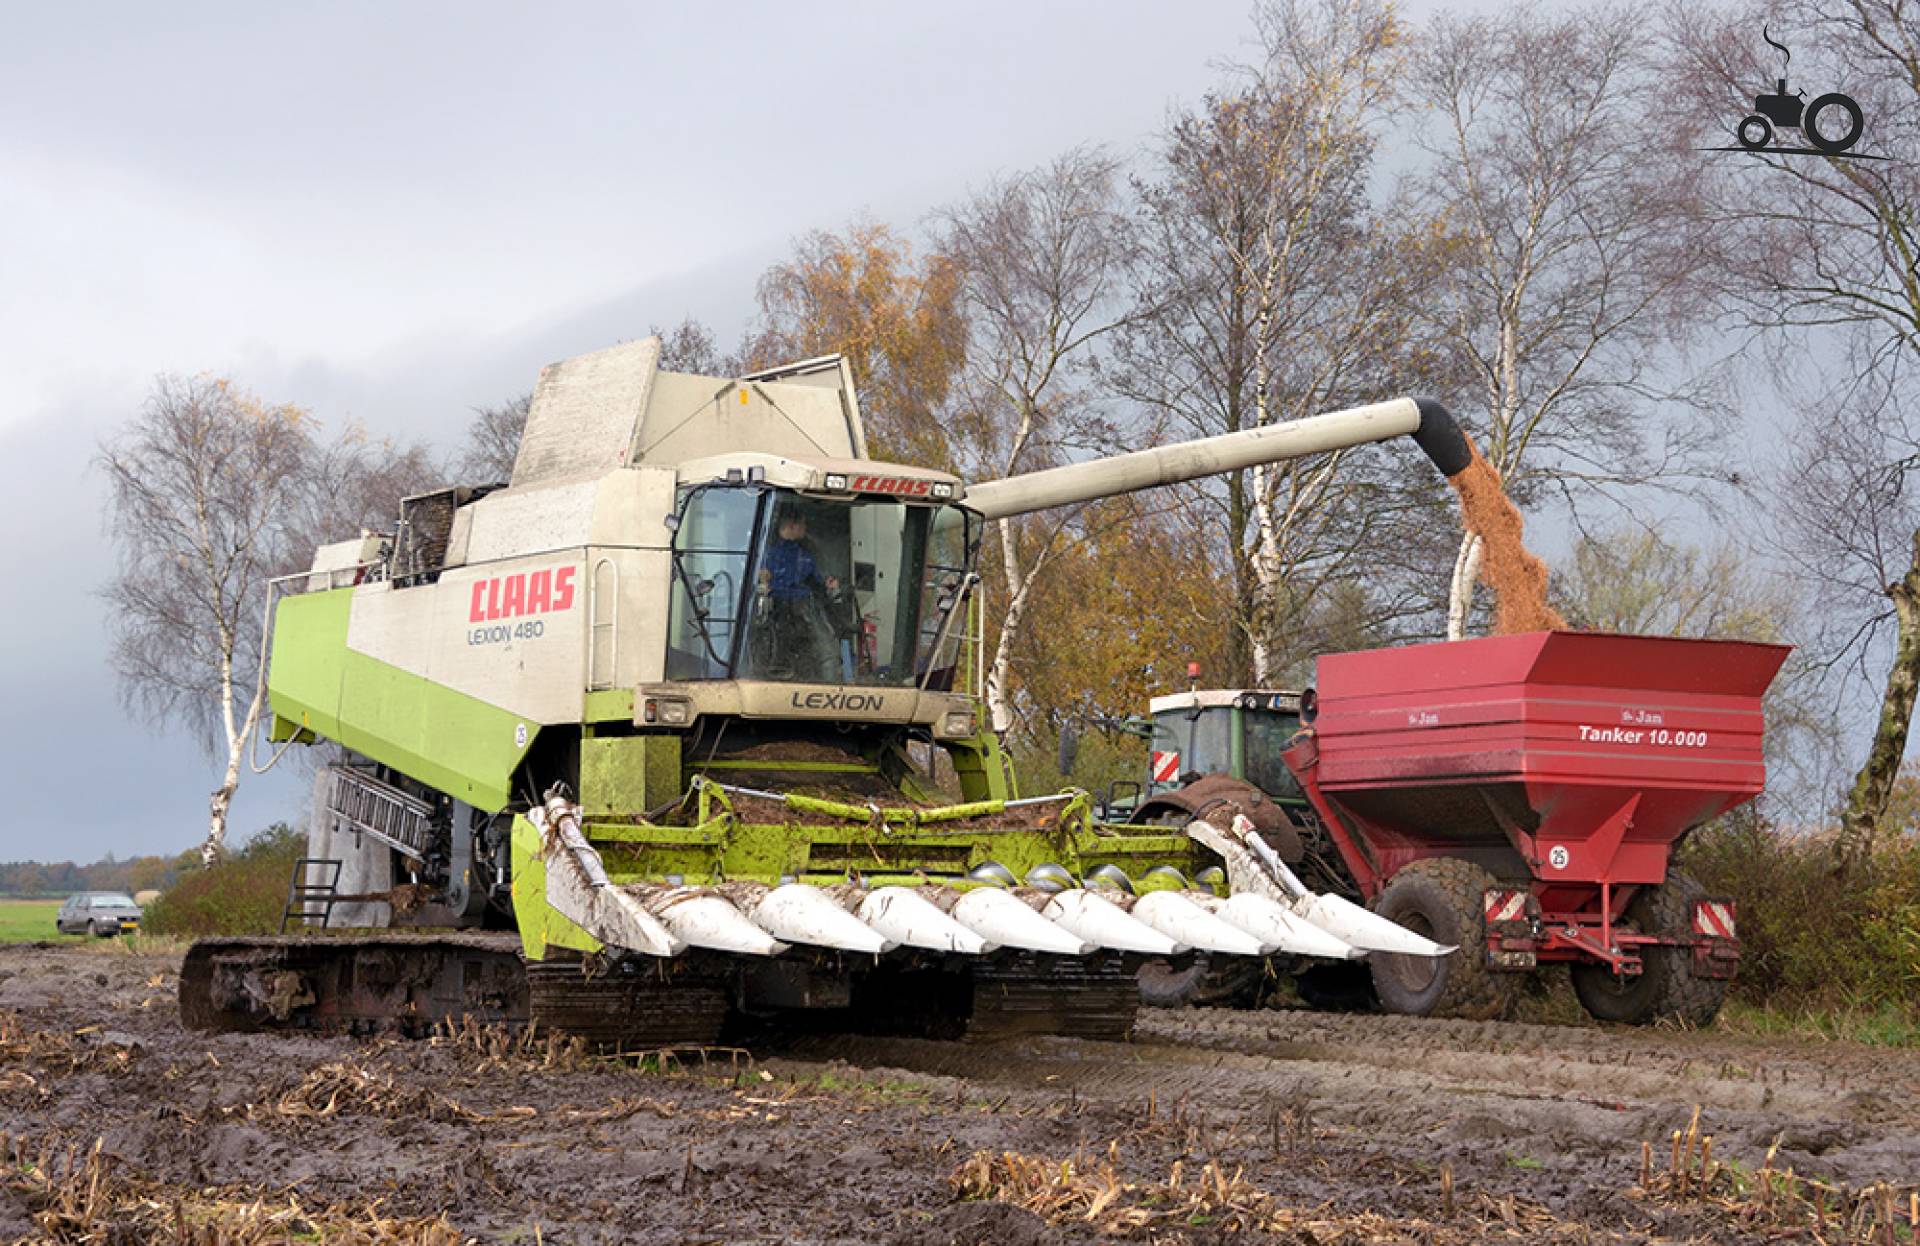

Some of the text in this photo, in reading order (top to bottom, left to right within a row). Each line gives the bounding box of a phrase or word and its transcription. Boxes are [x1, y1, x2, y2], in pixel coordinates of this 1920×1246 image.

[852, 476, 931, 495] CLAAS
[470, 566, 575, 622] CLAAS
[467, 621, 544, 646] LEXION 480
[792, 691, 884, 712] LEXION
[1579, 725, 1707, 747] Tanker 10.000
[1553, 849, 1565, 865] 25
